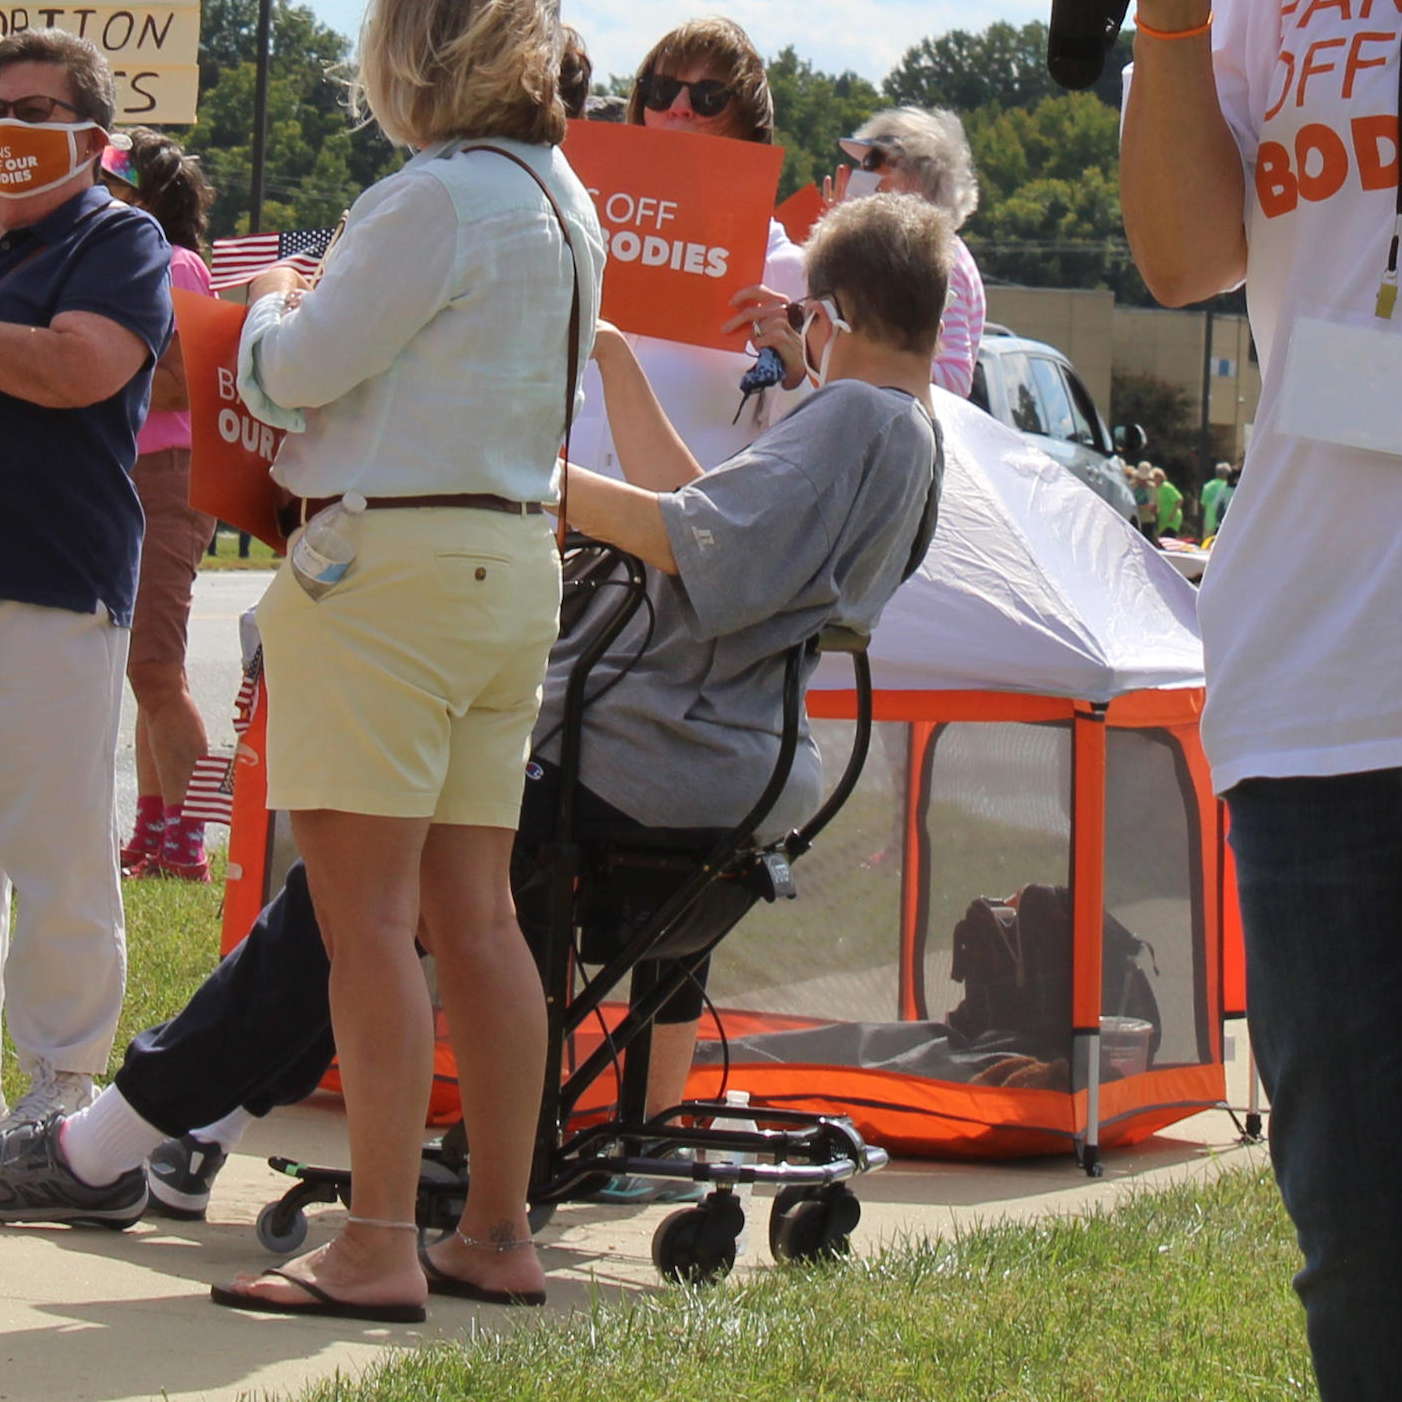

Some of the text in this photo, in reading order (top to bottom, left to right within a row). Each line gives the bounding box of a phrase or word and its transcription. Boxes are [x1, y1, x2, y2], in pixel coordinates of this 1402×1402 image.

[5, 155, 39, 171] OUR
[605, 192, 678, 230] OFF
[218, 407, 274, 462] OUR
